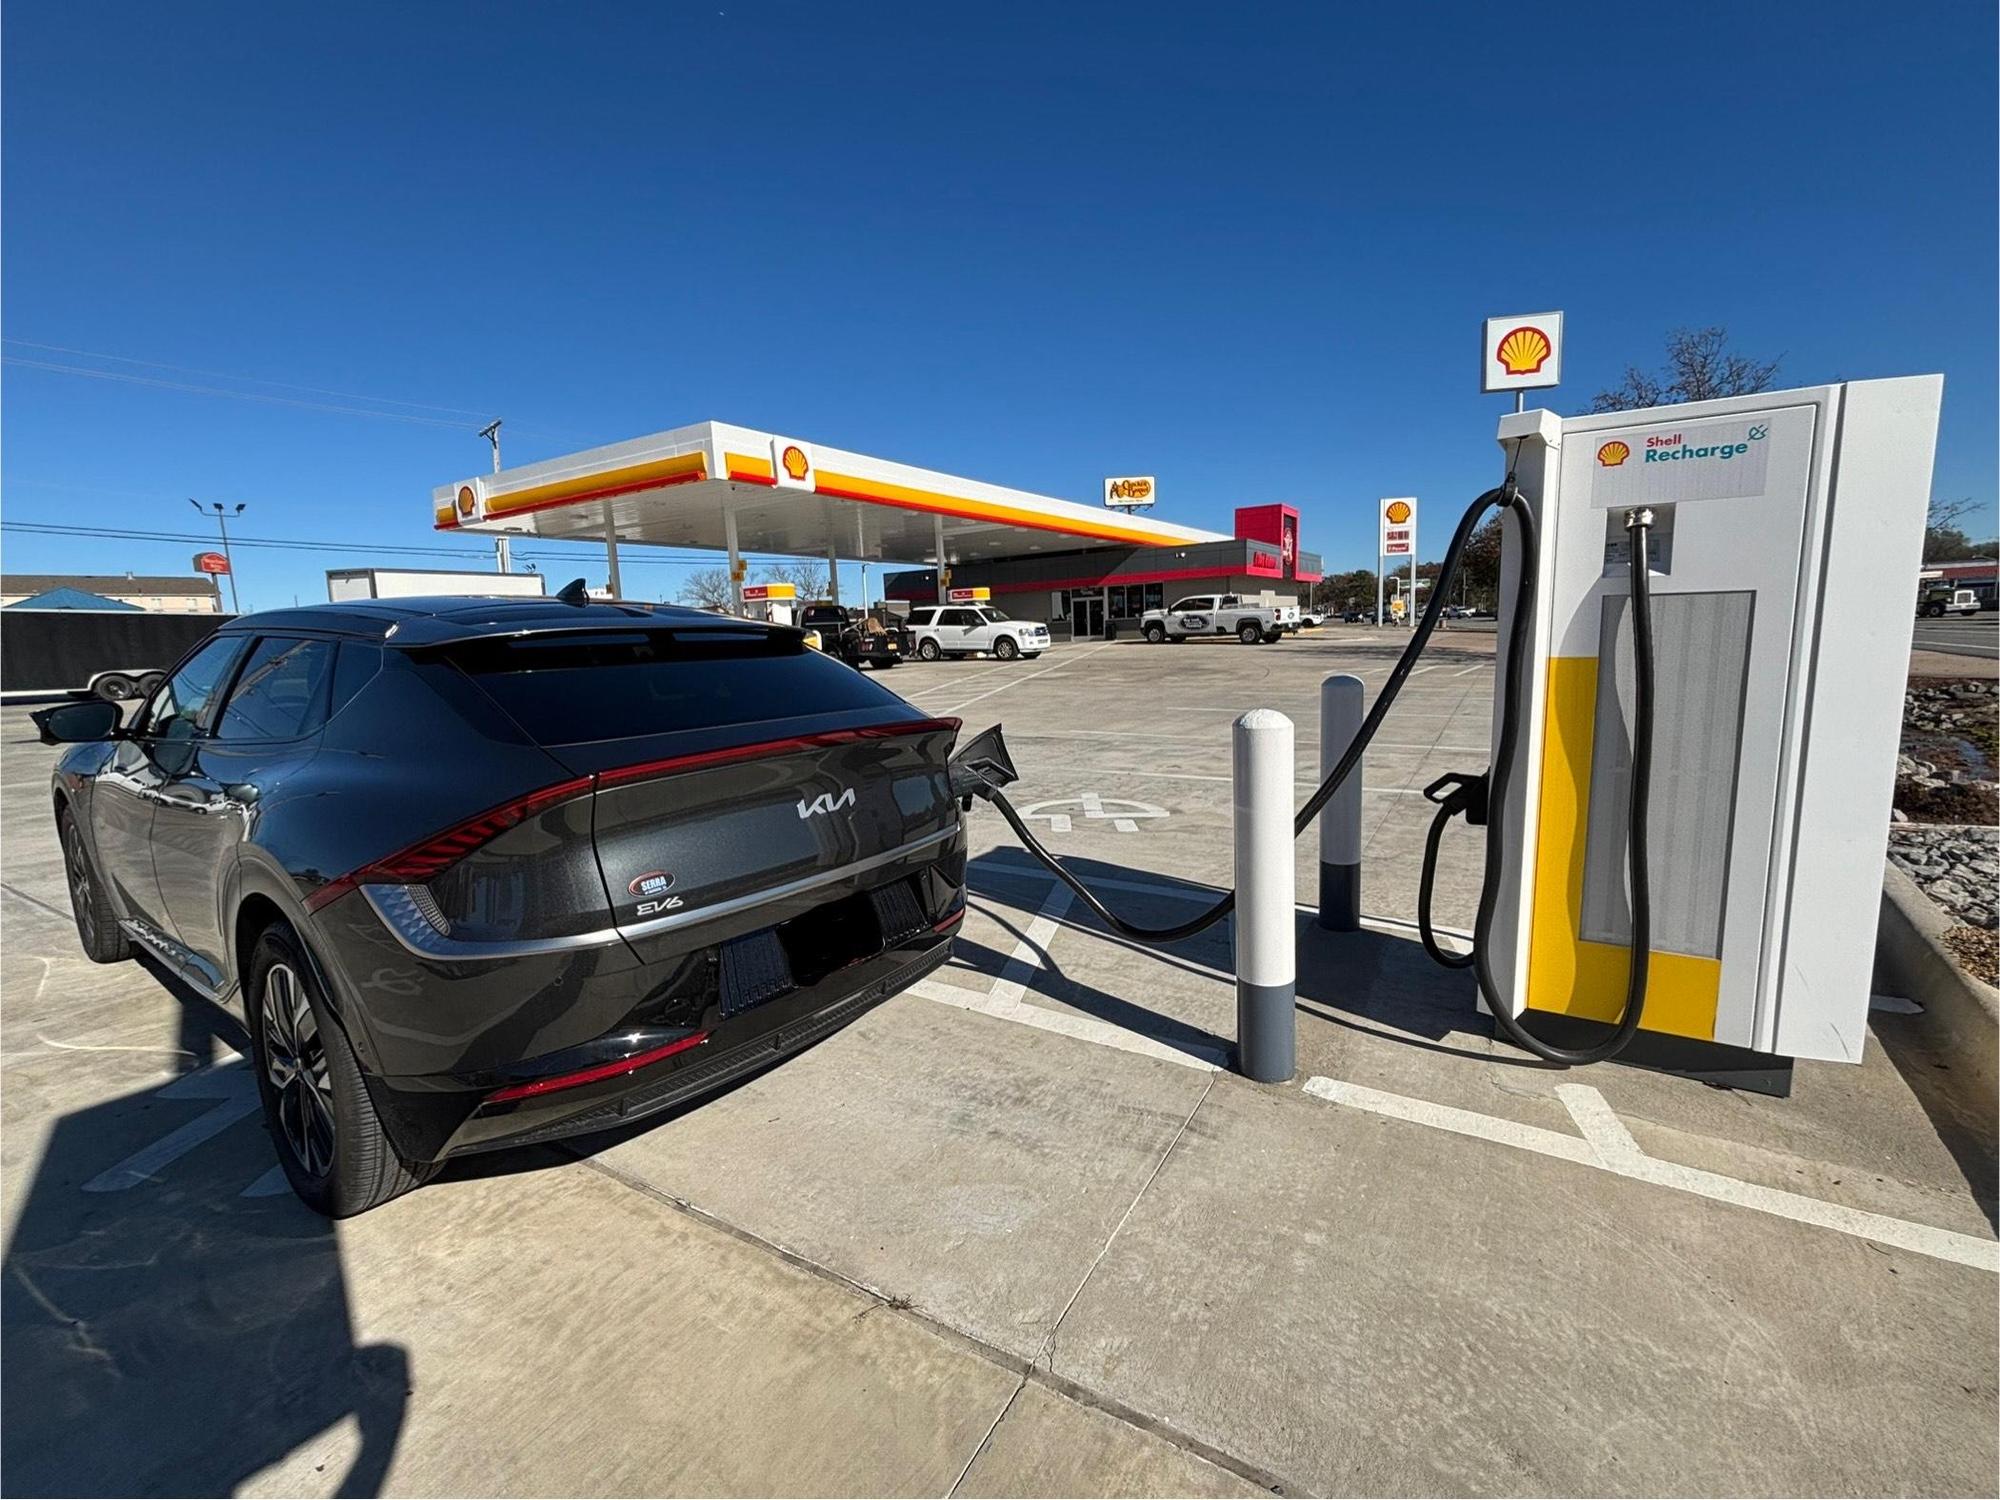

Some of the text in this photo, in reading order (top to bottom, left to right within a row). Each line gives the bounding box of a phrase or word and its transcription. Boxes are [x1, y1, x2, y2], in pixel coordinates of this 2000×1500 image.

[1646, 433, 1682, 447] Shell
[1645, 443, 1748, 463] Recharge
[797, 788, 856, 819] KIA
[641, 876, 667, 891] SERRA
[637, 896, 684, 916] EV6
